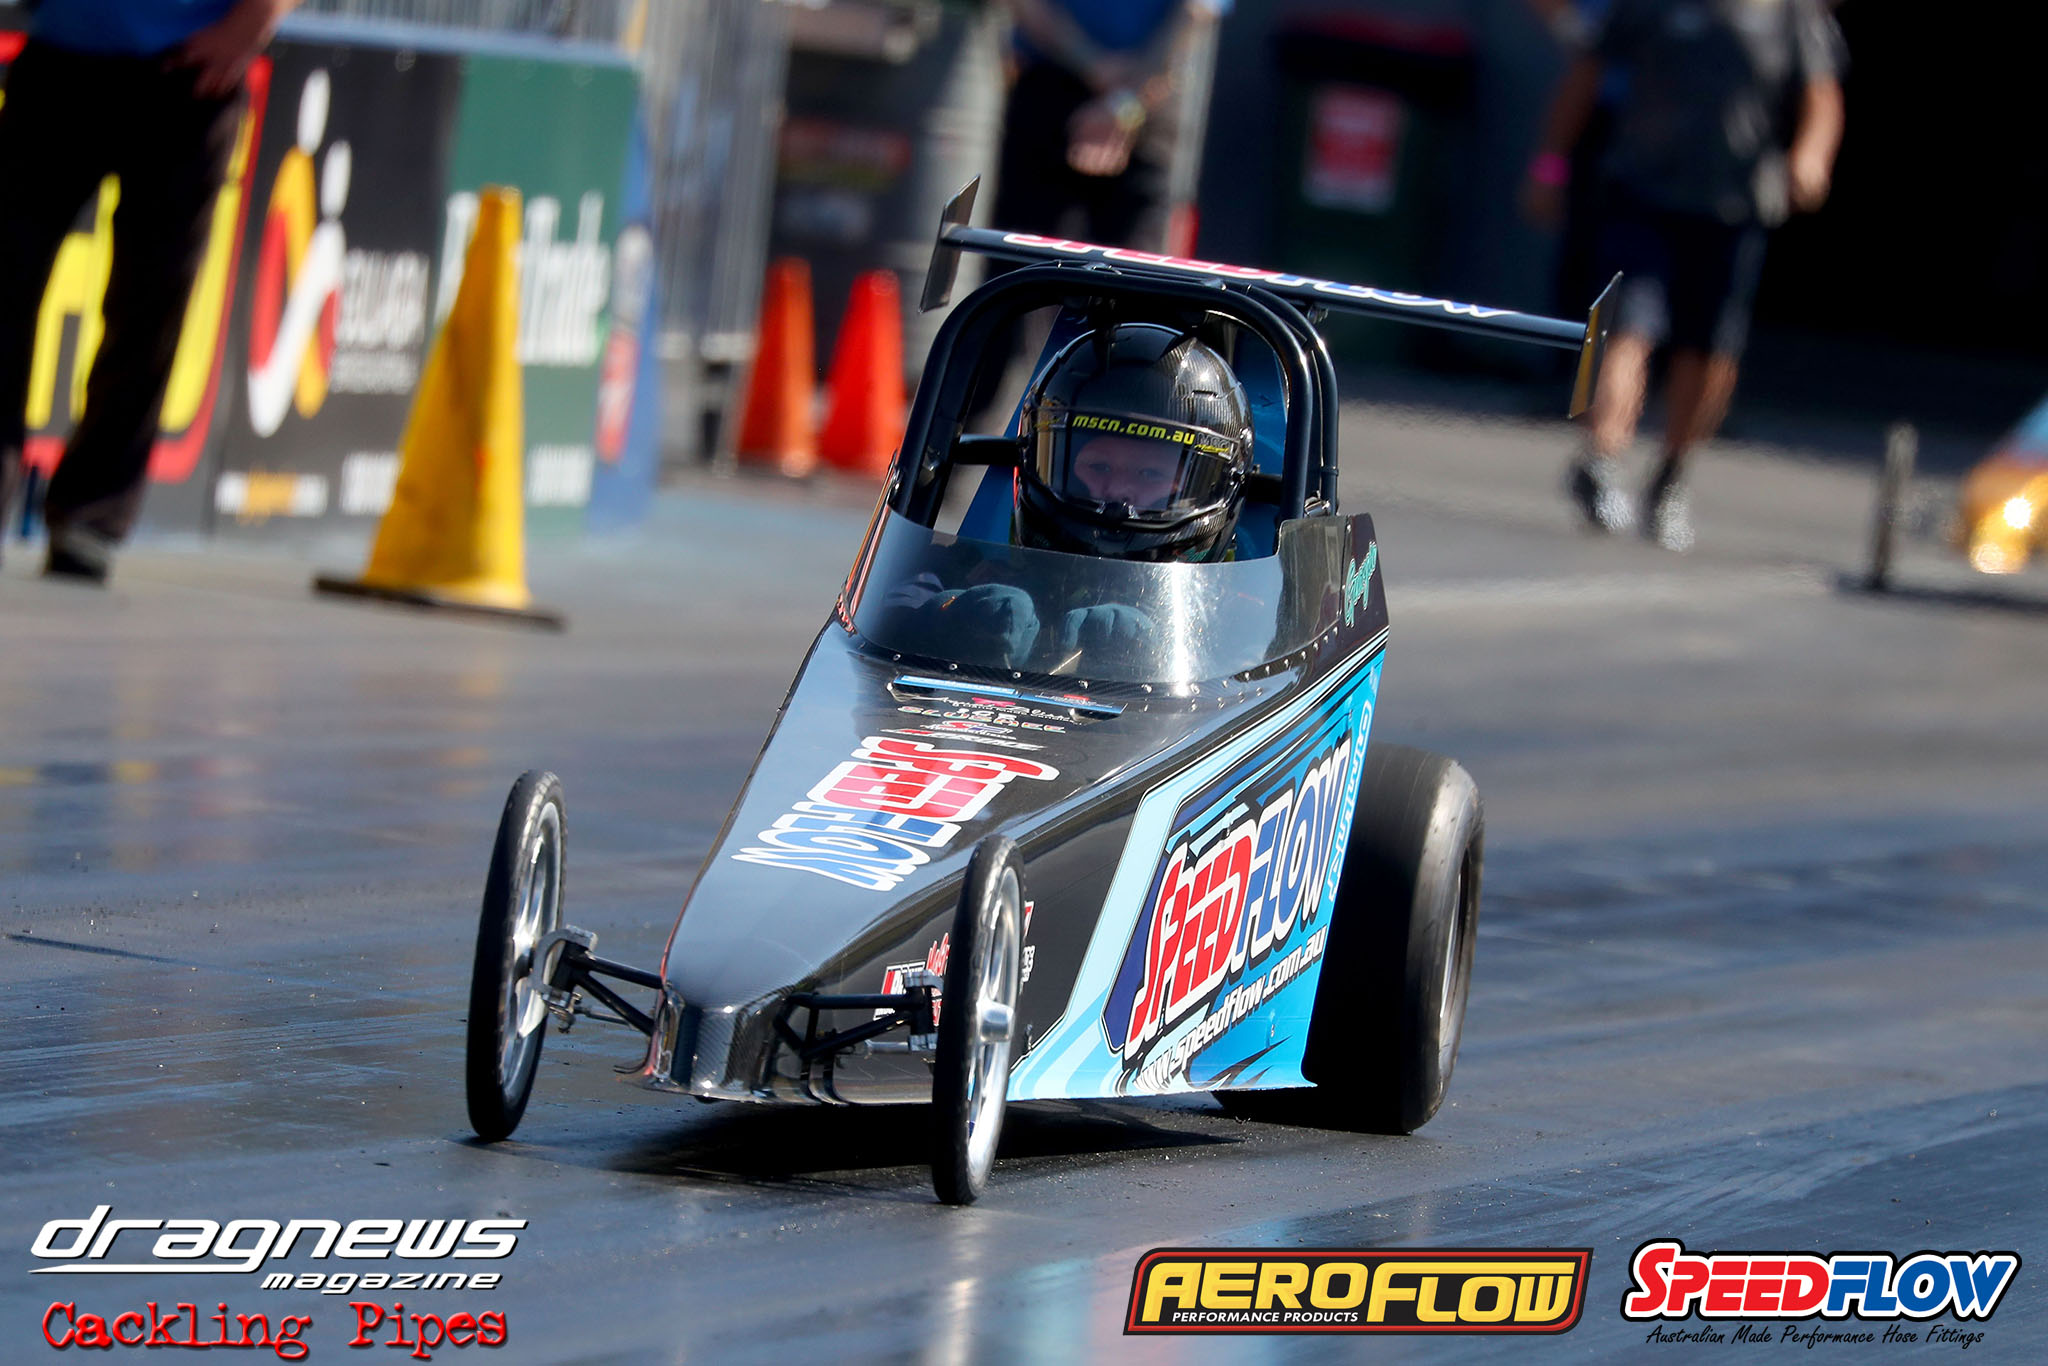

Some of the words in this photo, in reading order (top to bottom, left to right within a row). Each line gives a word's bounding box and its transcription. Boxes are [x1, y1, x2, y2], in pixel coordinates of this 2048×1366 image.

[1072, 415, 1196, 446] mscn.com.au
[731, 736, 1060, 891] SPEEDFLOW
[1124, 737, 1352, 1060] SPEEDFLOW
